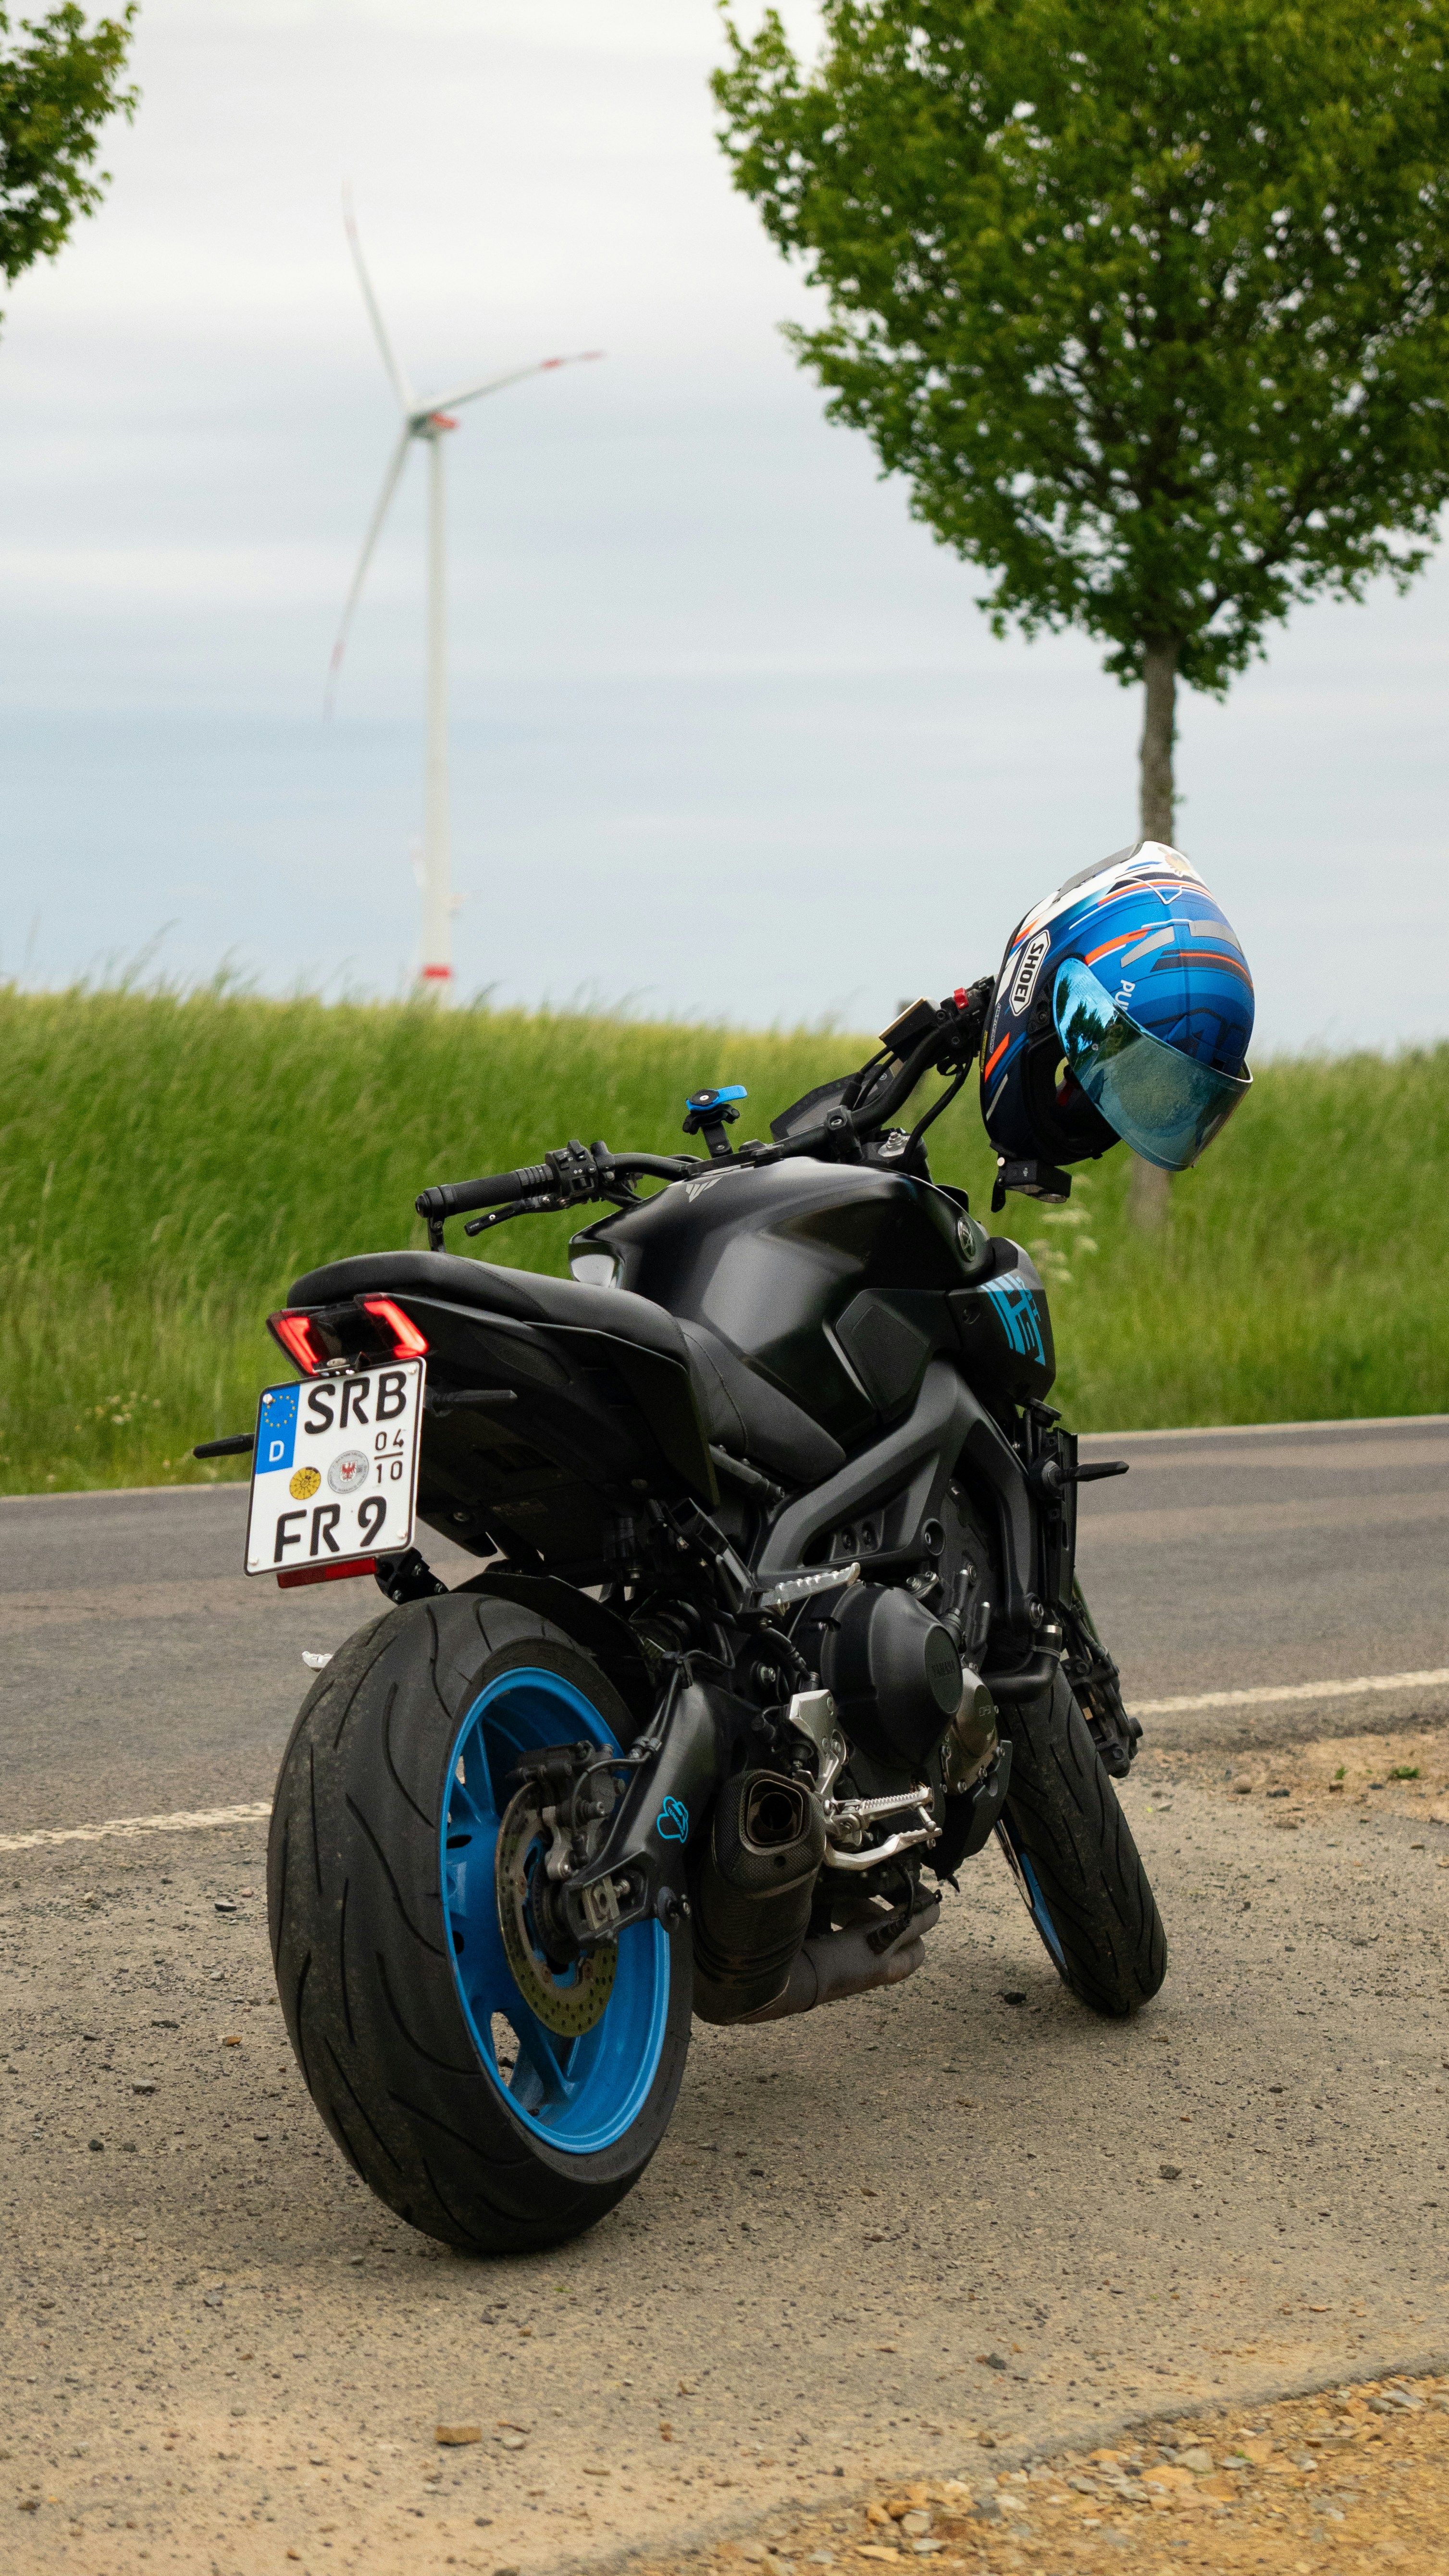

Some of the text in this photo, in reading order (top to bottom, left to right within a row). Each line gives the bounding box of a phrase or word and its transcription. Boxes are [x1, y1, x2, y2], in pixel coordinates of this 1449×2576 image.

[1014, 943, 1044, 1002] SHOEI
[304, 1371, 407, 1434] SRB
[269, 1440, 284, 1462] D
[375, 1429, 404, 1450] 04
[377, 1461, 402, 1483] 10
[274, 1496, 386, 1562] FR 9
